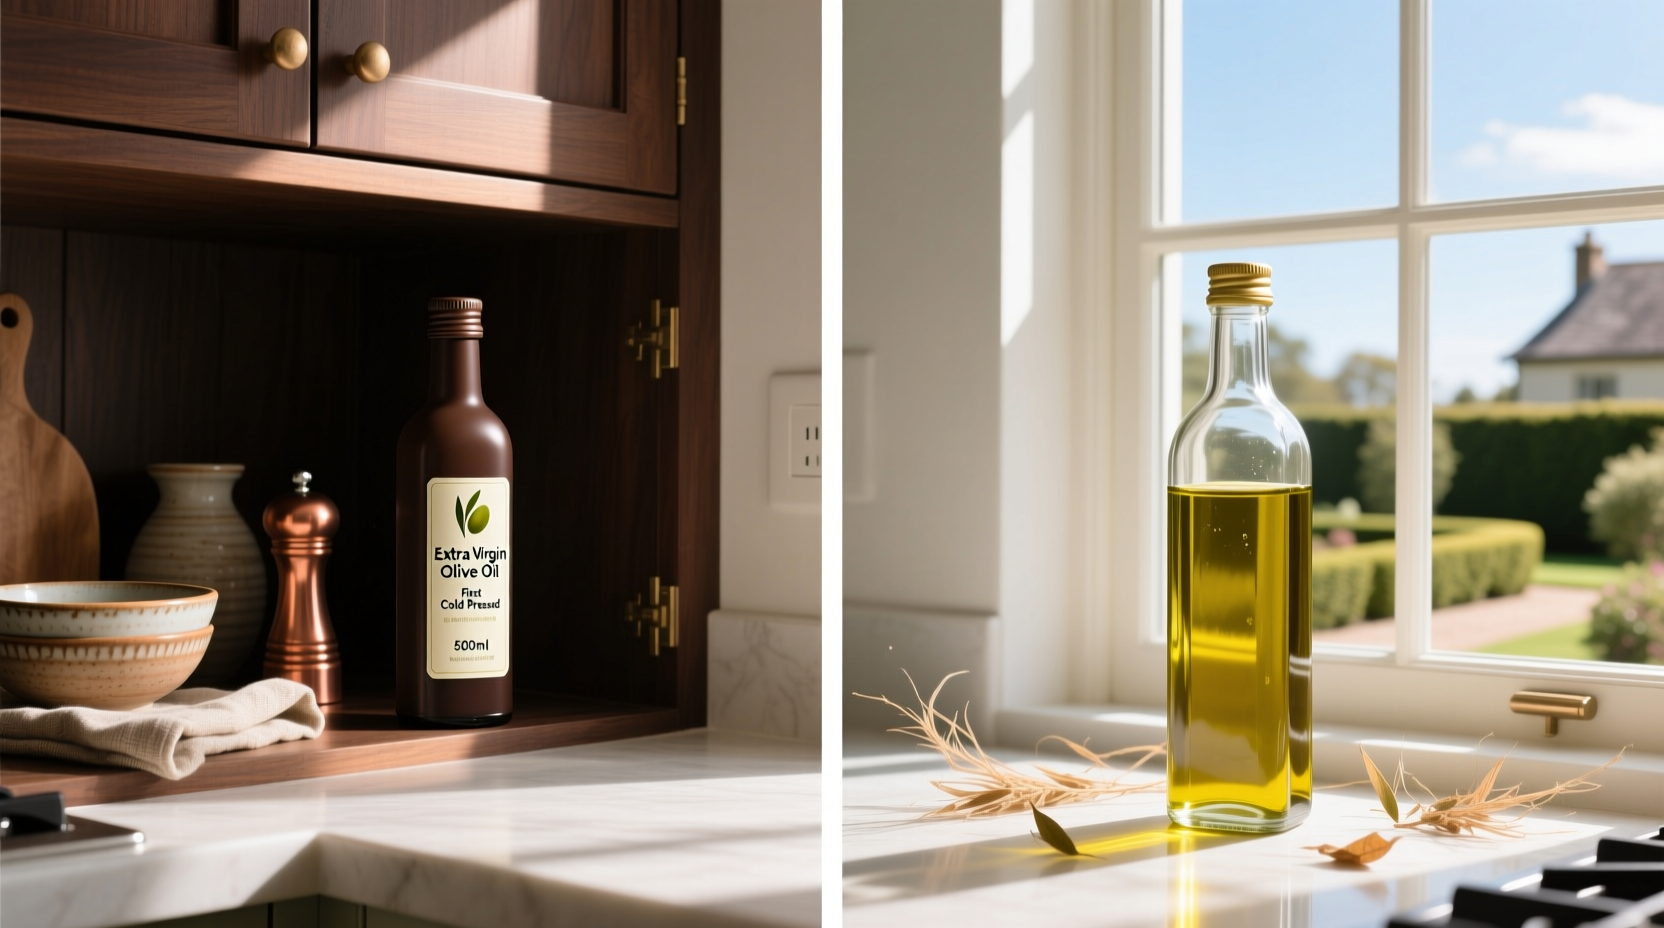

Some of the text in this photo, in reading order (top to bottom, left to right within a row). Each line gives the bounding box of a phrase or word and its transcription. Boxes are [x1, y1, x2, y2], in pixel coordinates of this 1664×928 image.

[434, 546, 507, 564] Extra Virgin
[440, 564, 499, 578] Olive Oil
[440, 599, 464, 609] Cold
[454, 639, 489, 651] 500ml
